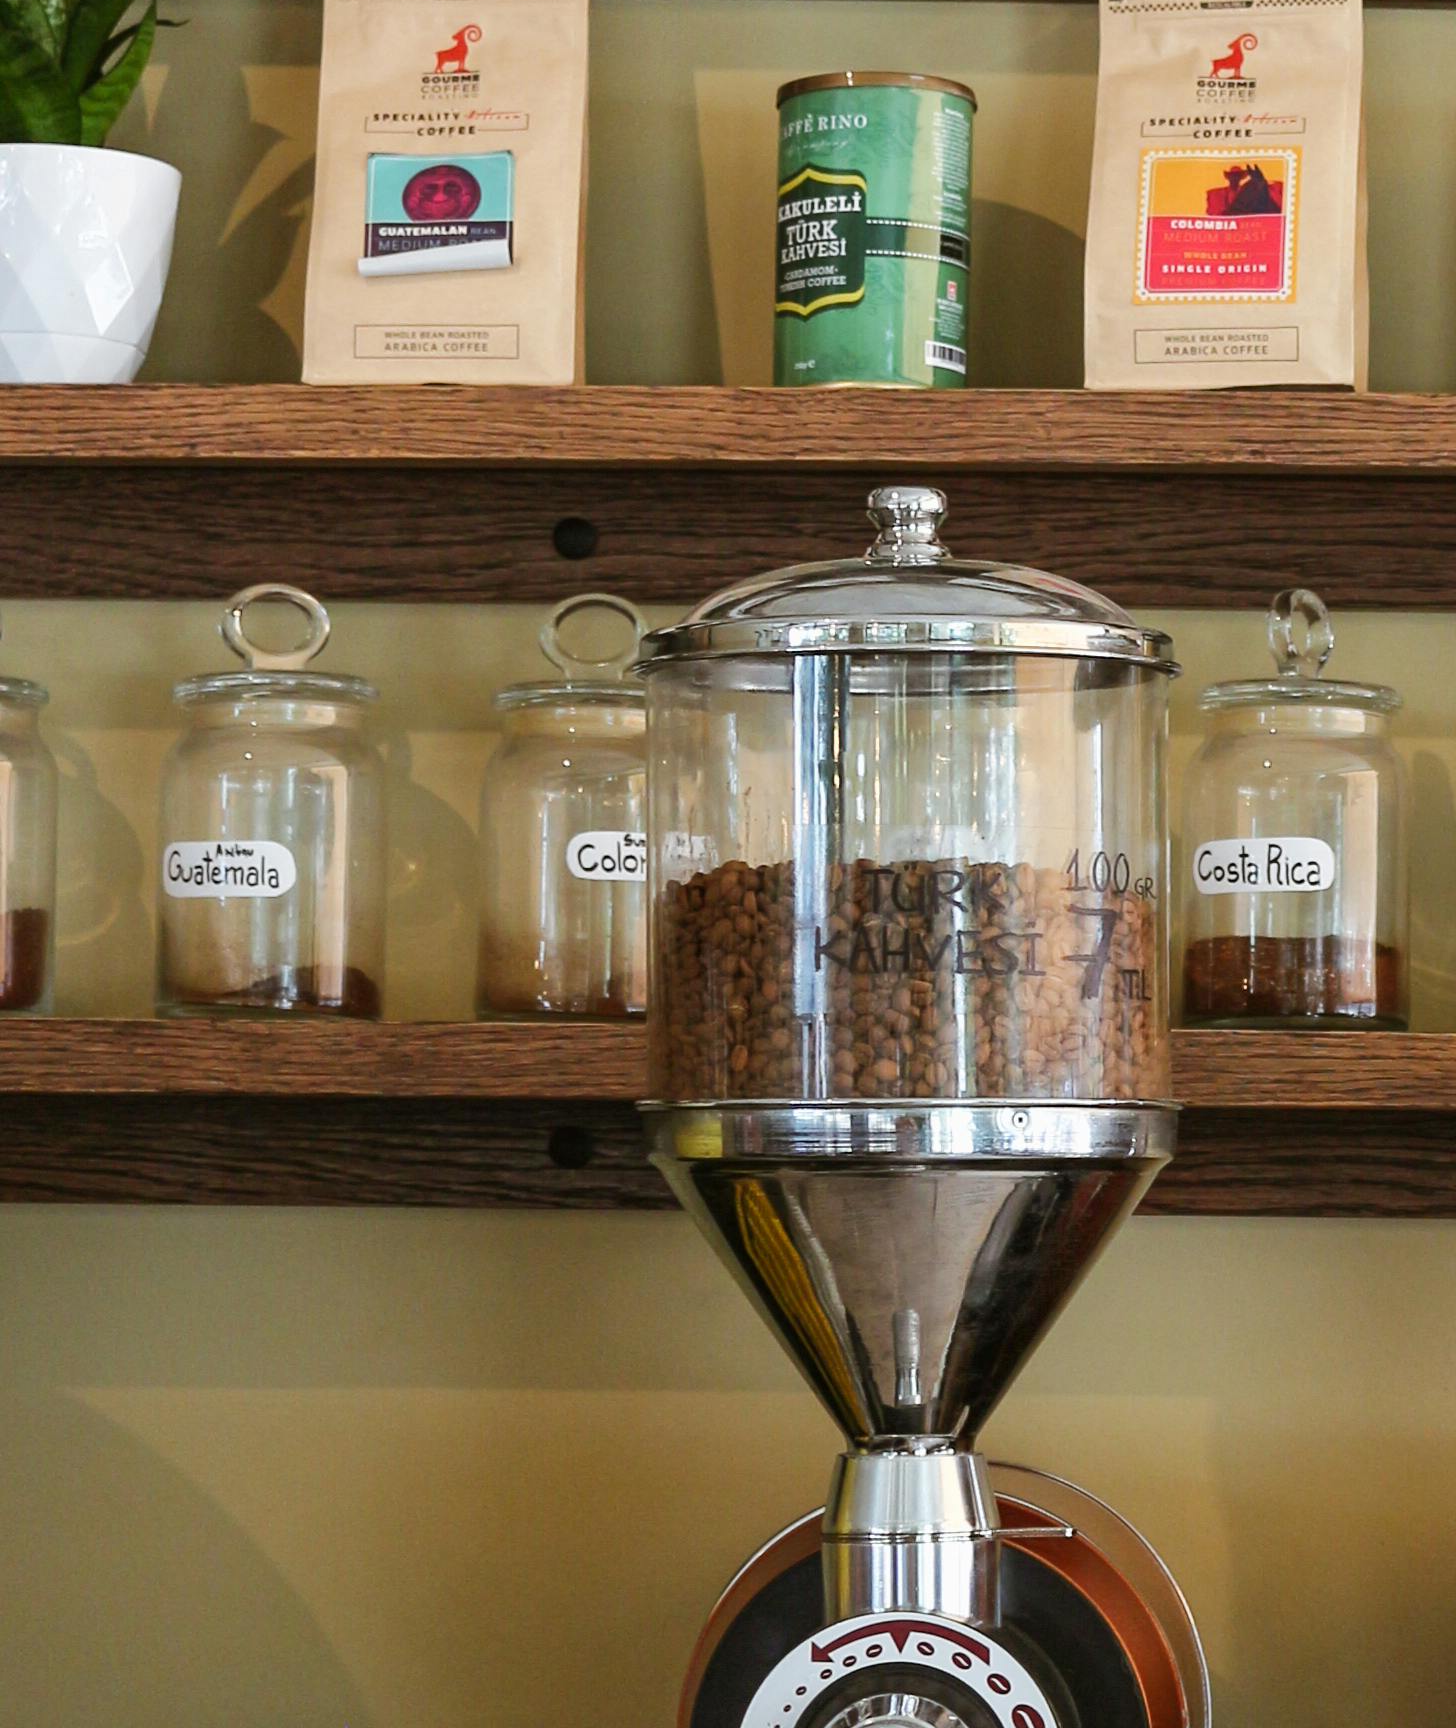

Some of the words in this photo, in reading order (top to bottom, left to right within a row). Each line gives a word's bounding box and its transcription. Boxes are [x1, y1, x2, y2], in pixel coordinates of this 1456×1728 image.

[421, 74, 480, 83] GOURME
[420, 83, 480, 94] COFFEE
[1197, 80, 1256, 89] GOURME
[1196, 89, 1256, 98] COFFEE
[373, 112, 460, 122] SPECIALITY
[817, 114, 868, 131] RINO
[1150, 116, 1236, 126] SPECIALITY
[417, 126, 476, 136] COFFEE
[1193, 129, 1253, 139] COFFEE
[778, 191, 862, 222] KAKULELİ
[1170, 219, 1237, 230] COLOMBIA
[378, 225, 467, 237] GUATEMALAN
[786, 219, 838, 246] TÜRK
[378, 239, 441, 251] MEDIUM
[781, 238, 847, 264] KAHVESİ
[1162, 265, 1211, 273] SINGLE
[1218, 264, 1267, 273] ORIGIN
[807, 275, 846, 287] COFFEE
[1227, 334, 1269, 342] ROASTED
[385, 343, 437, 352] ARABICA
[443, 343, 488, 352] COFFEE
[1165, 346, 1218, 355] ARABICA
[1223, 345, 1269, 355] COFFEE
[168, 850, 280, 889] Guatemala
[1198, 845, 1258, 885] Costa
[1267, 843, 1321, 886] Rica
[1061, 849, 1130, 894] 100
[861, 863, 1005, 914] TÜRK
[815, 920, 1046, 976] KAHVESİ
[1061, 903, 1121, 1000] 7
